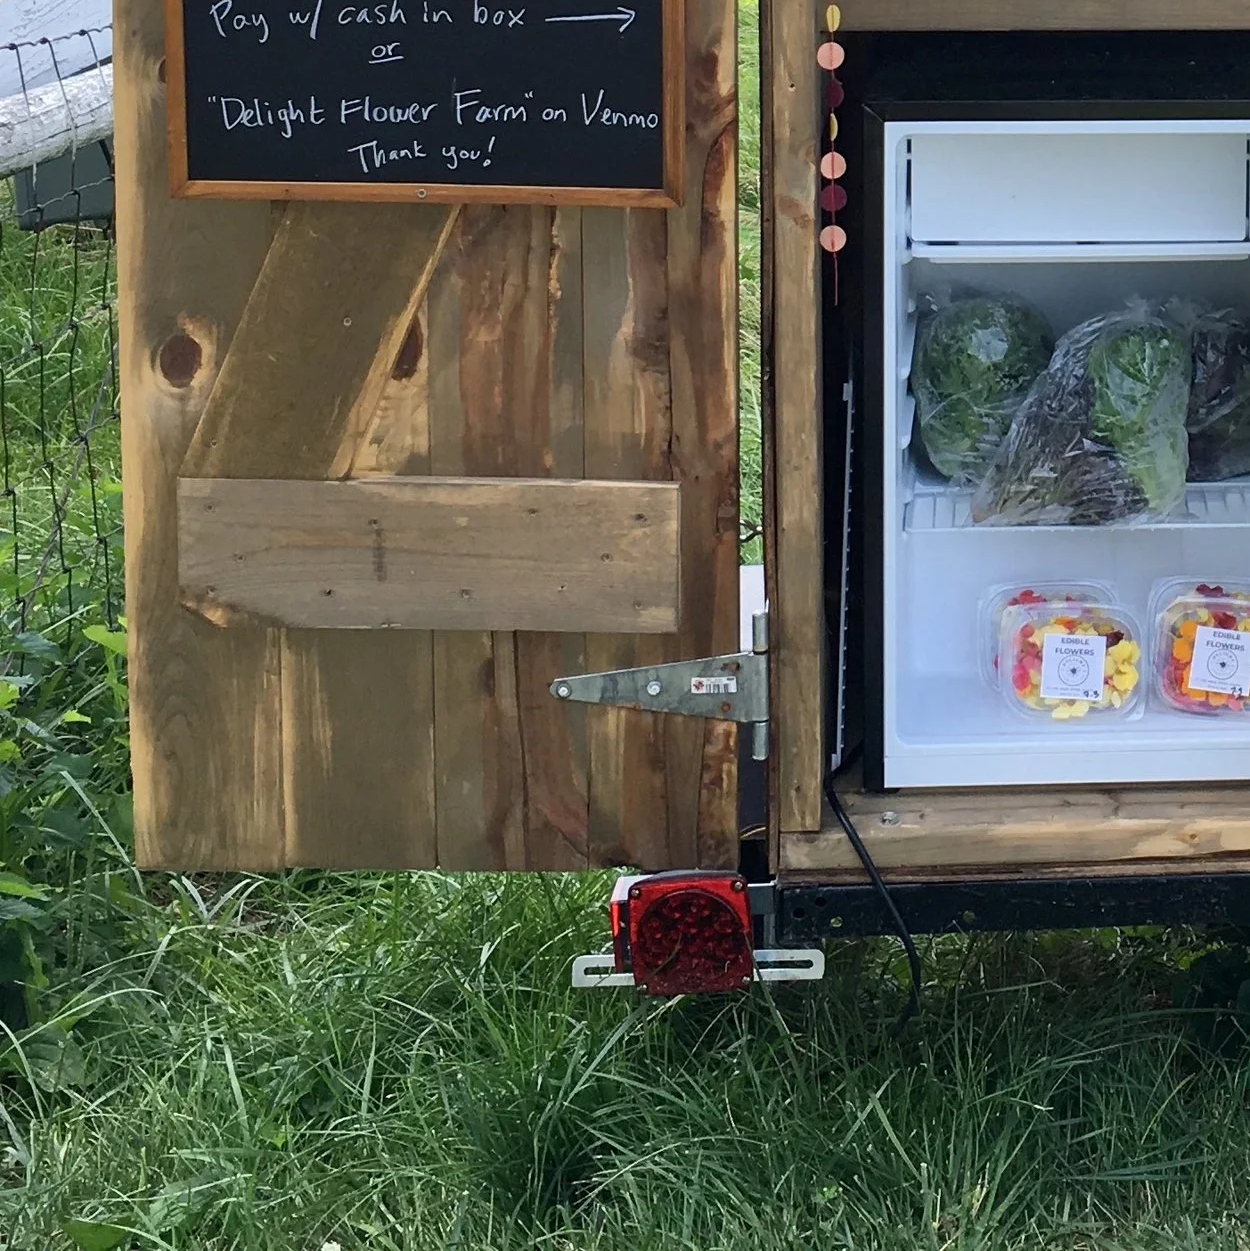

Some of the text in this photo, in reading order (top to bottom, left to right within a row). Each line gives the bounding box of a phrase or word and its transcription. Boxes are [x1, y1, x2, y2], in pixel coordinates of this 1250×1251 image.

[209, 0, 269, 44] Pay
[423, 1, 453, 23] in
[371, 42, 402, 58] or
[340, 95, 438, 124] Flower
[541, 108, 567, 122] on
[581, 88, 659, 129] Venmo
[347, 135, 496, 174] Thank you!
[1061, 637, 1090, 646] EDIBLE
[1212, 631, 1241, 641] EDIBLE
[1055, 647, 1095, 656] FLOWERS
[1205, 640, 1245, 651] FLOWERS
